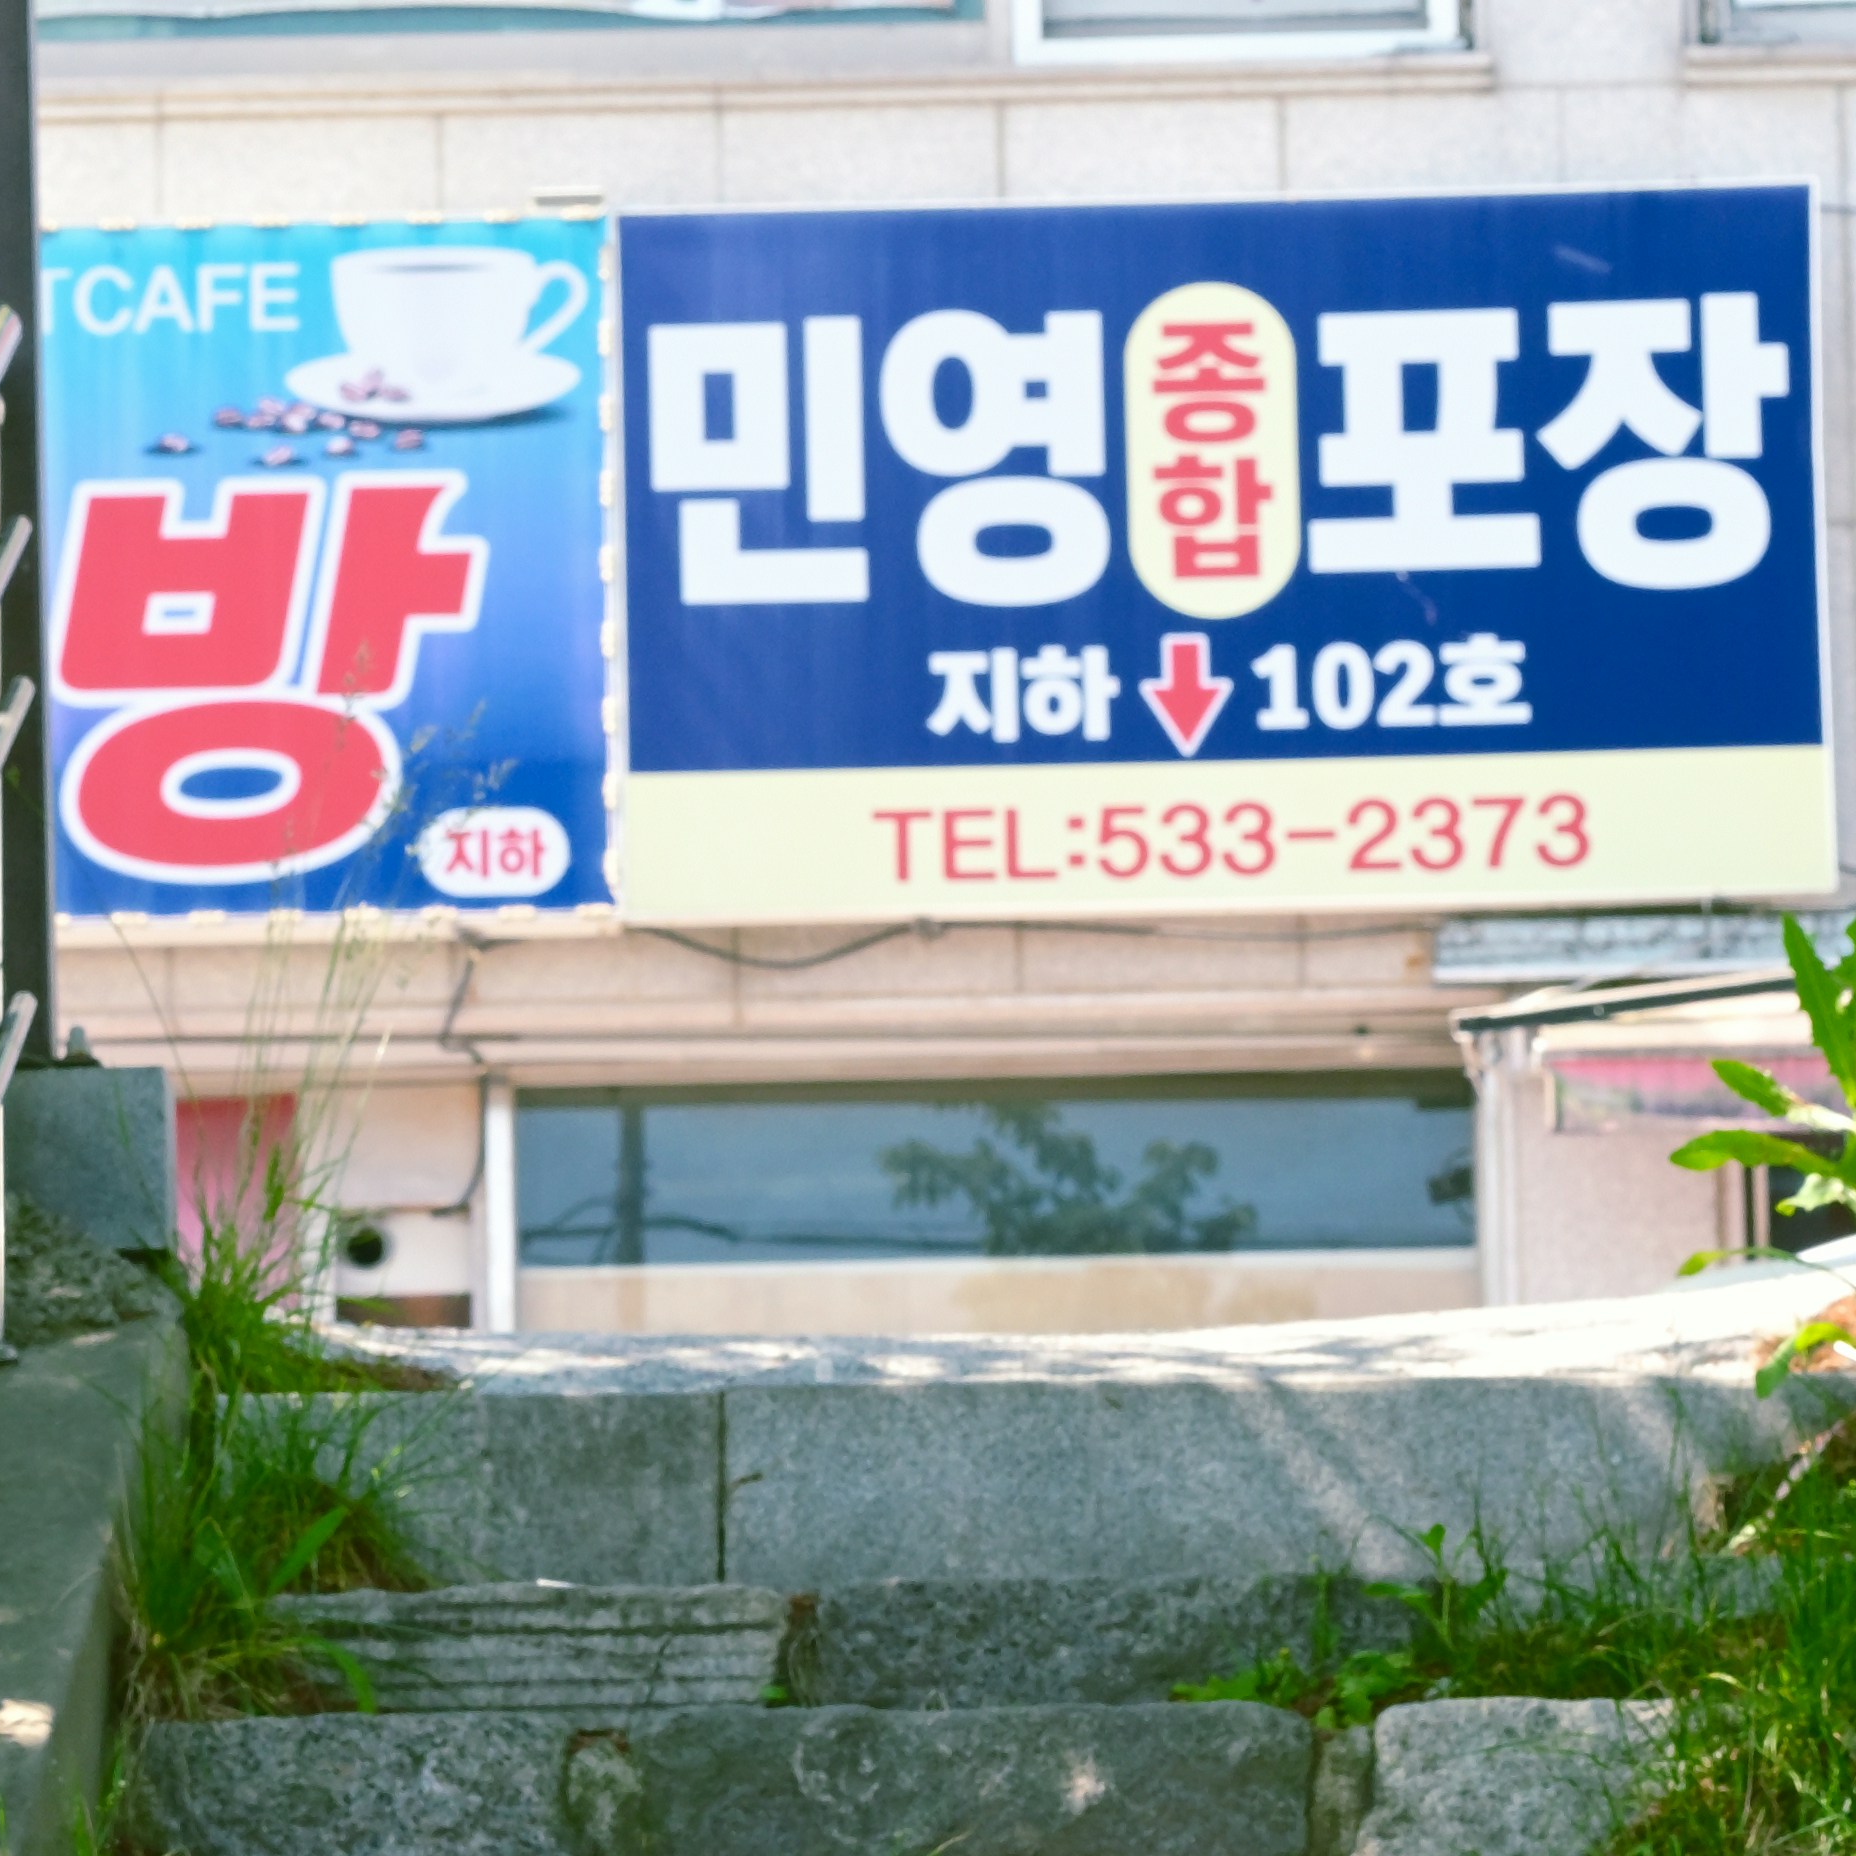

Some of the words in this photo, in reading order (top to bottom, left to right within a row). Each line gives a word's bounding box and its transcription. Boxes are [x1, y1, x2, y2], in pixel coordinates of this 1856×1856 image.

[646, 306, 1111, 607] 민영
[1152, 320, 1273, 580] 종합
[1306, 290, 1791, 591] 포장
[925, 645, 1120, 743] 지하
[1248, 632, 1533, 731] 102호
[443, 825, 548, 880] 지하
[872, 792, 1593, 883] TEL:533-2373
